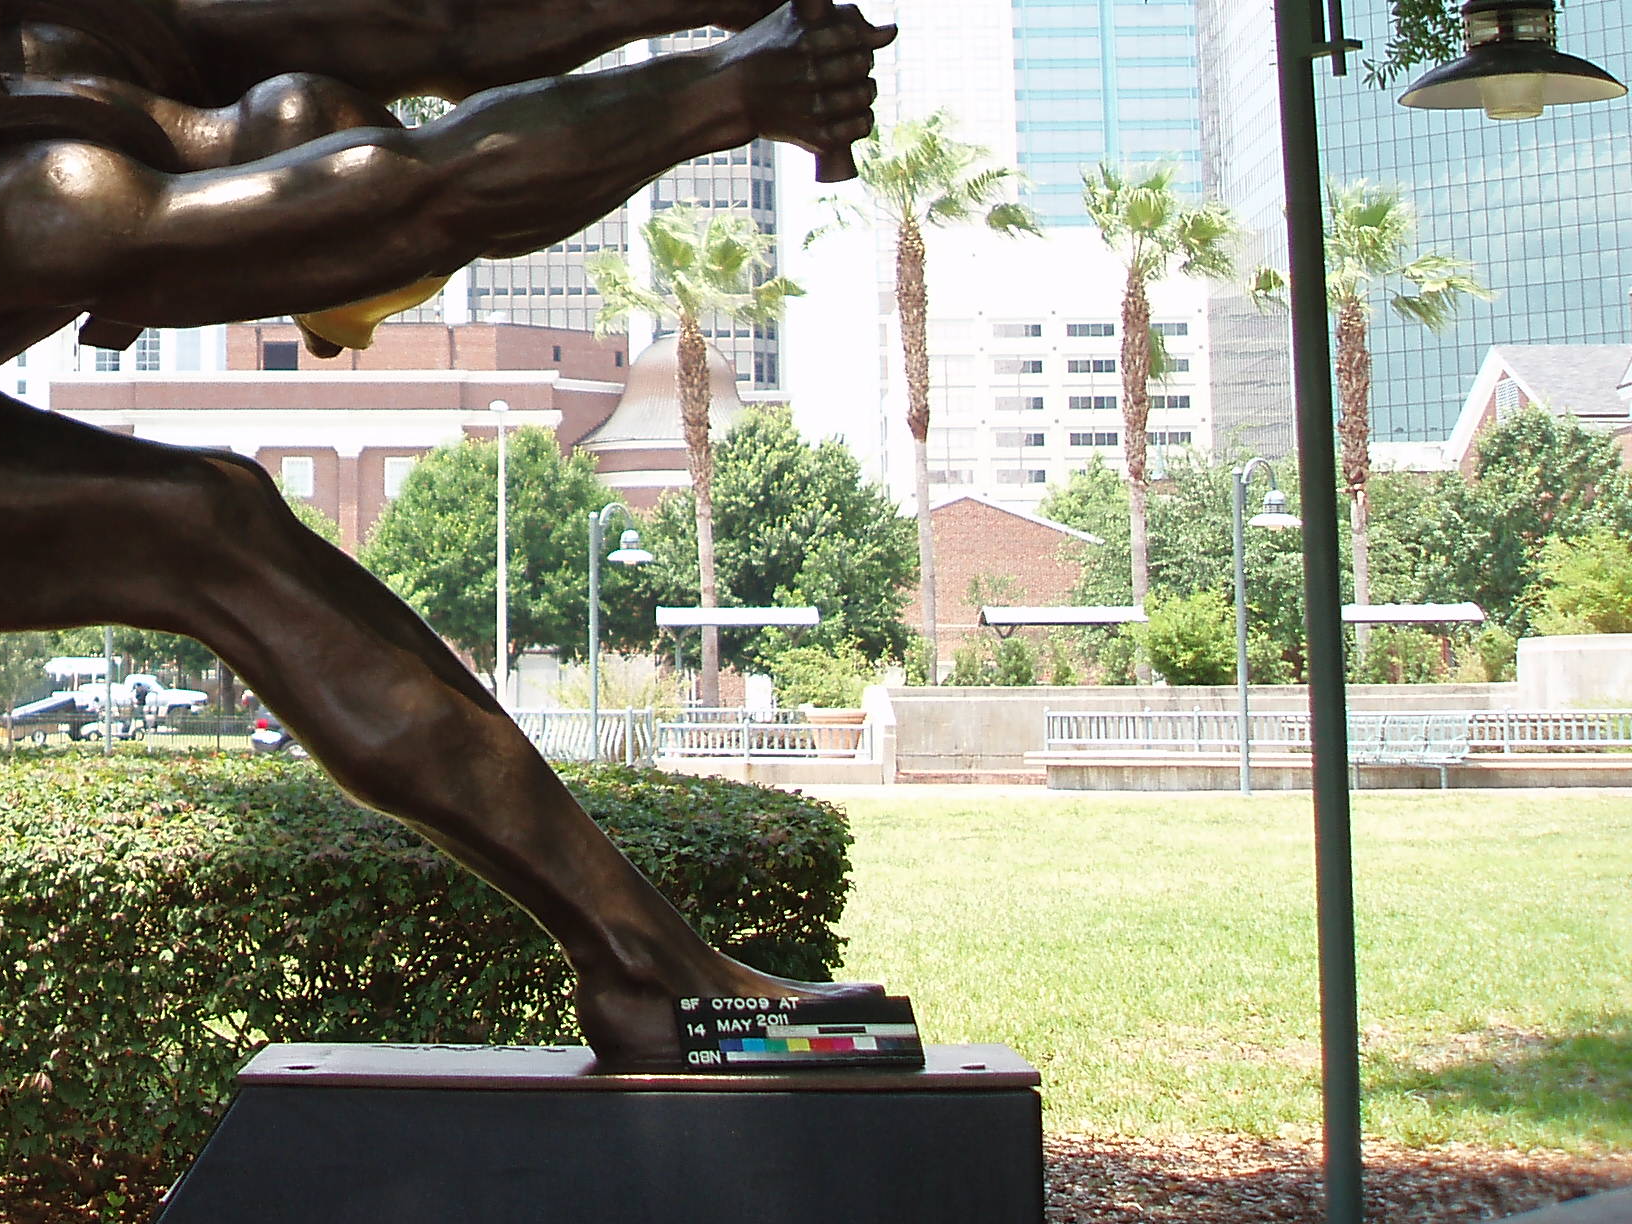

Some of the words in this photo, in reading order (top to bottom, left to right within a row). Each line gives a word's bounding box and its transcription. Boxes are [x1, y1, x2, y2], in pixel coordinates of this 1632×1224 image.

[711, 997, 770, 1010] 07009
[779, 996, 799, 1010] AT
[687, 1023, 706, 1037] 14
[716, 1019, 752, 1032] MAY
[756, 1013, 789, 1027] 2011
